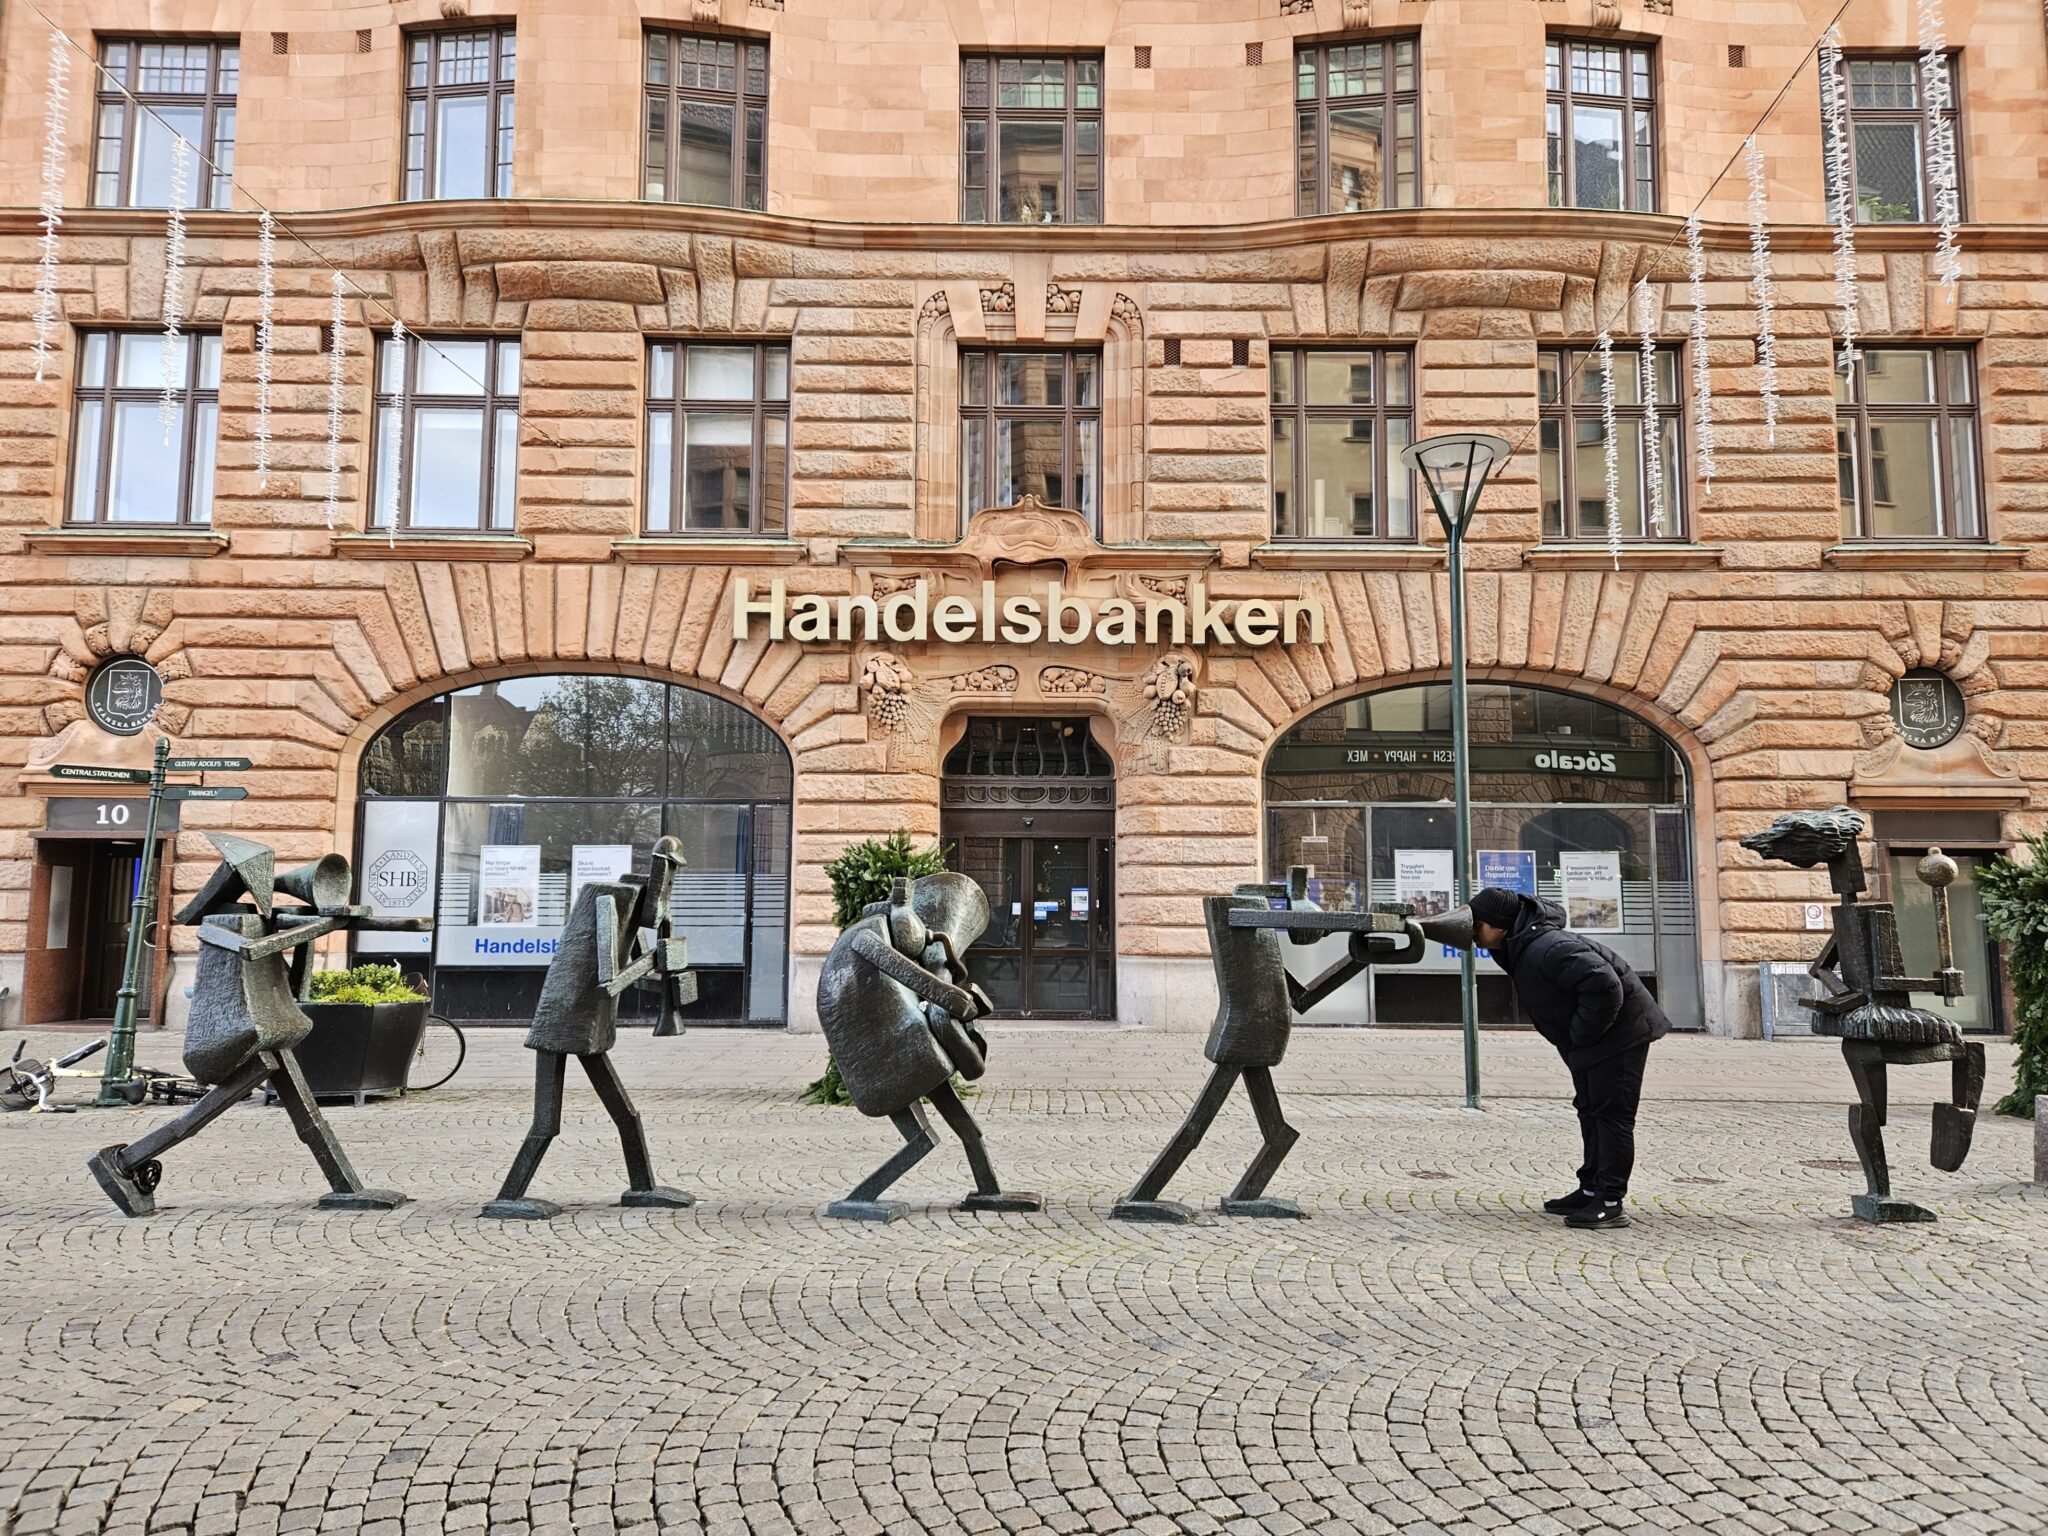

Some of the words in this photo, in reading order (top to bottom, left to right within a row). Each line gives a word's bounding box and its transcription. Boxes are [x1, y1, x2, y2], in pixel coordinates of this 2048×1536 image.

[732, 577, 1326, 646] Handelsbanken
[1929, 715, 1960, 744] BANKEN
[60, 768, 131, 779] CENTRALSTATIONEN
[95, 804, 130, 825] 10
[378, 871, 417, 887] SHB
